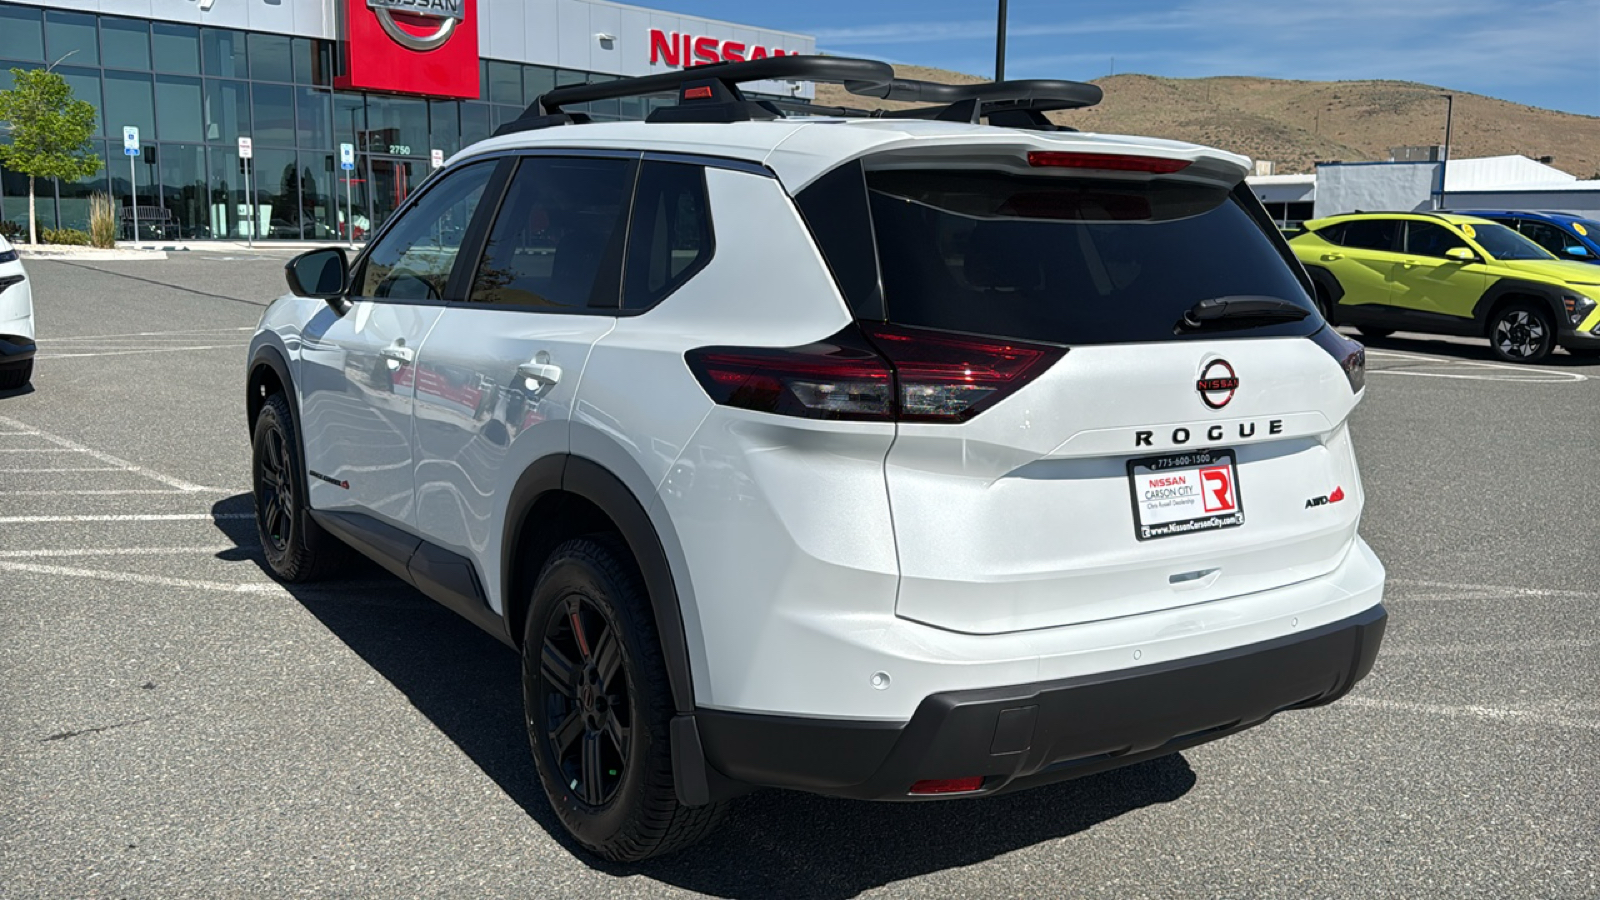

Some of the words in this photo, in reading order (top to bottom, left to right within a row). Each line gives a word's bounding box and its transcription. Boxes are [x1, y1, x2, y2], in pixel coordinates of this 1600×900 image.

[389, 144, 411, 155] 2750
[1199, 379, 1239, 390] NISSAN
[1135, 419, 1283, 447] ROGUE
[1158, 454, 1211, 467] 775-600-1500
[1149, 475, 1186, 488] NISSAN
[1145, 488, 1176, 500] CARSON
[1177, 485, 1194, 496] CITY
[1150, 517, 1235, 535] www.NissanCarsonCity.com
